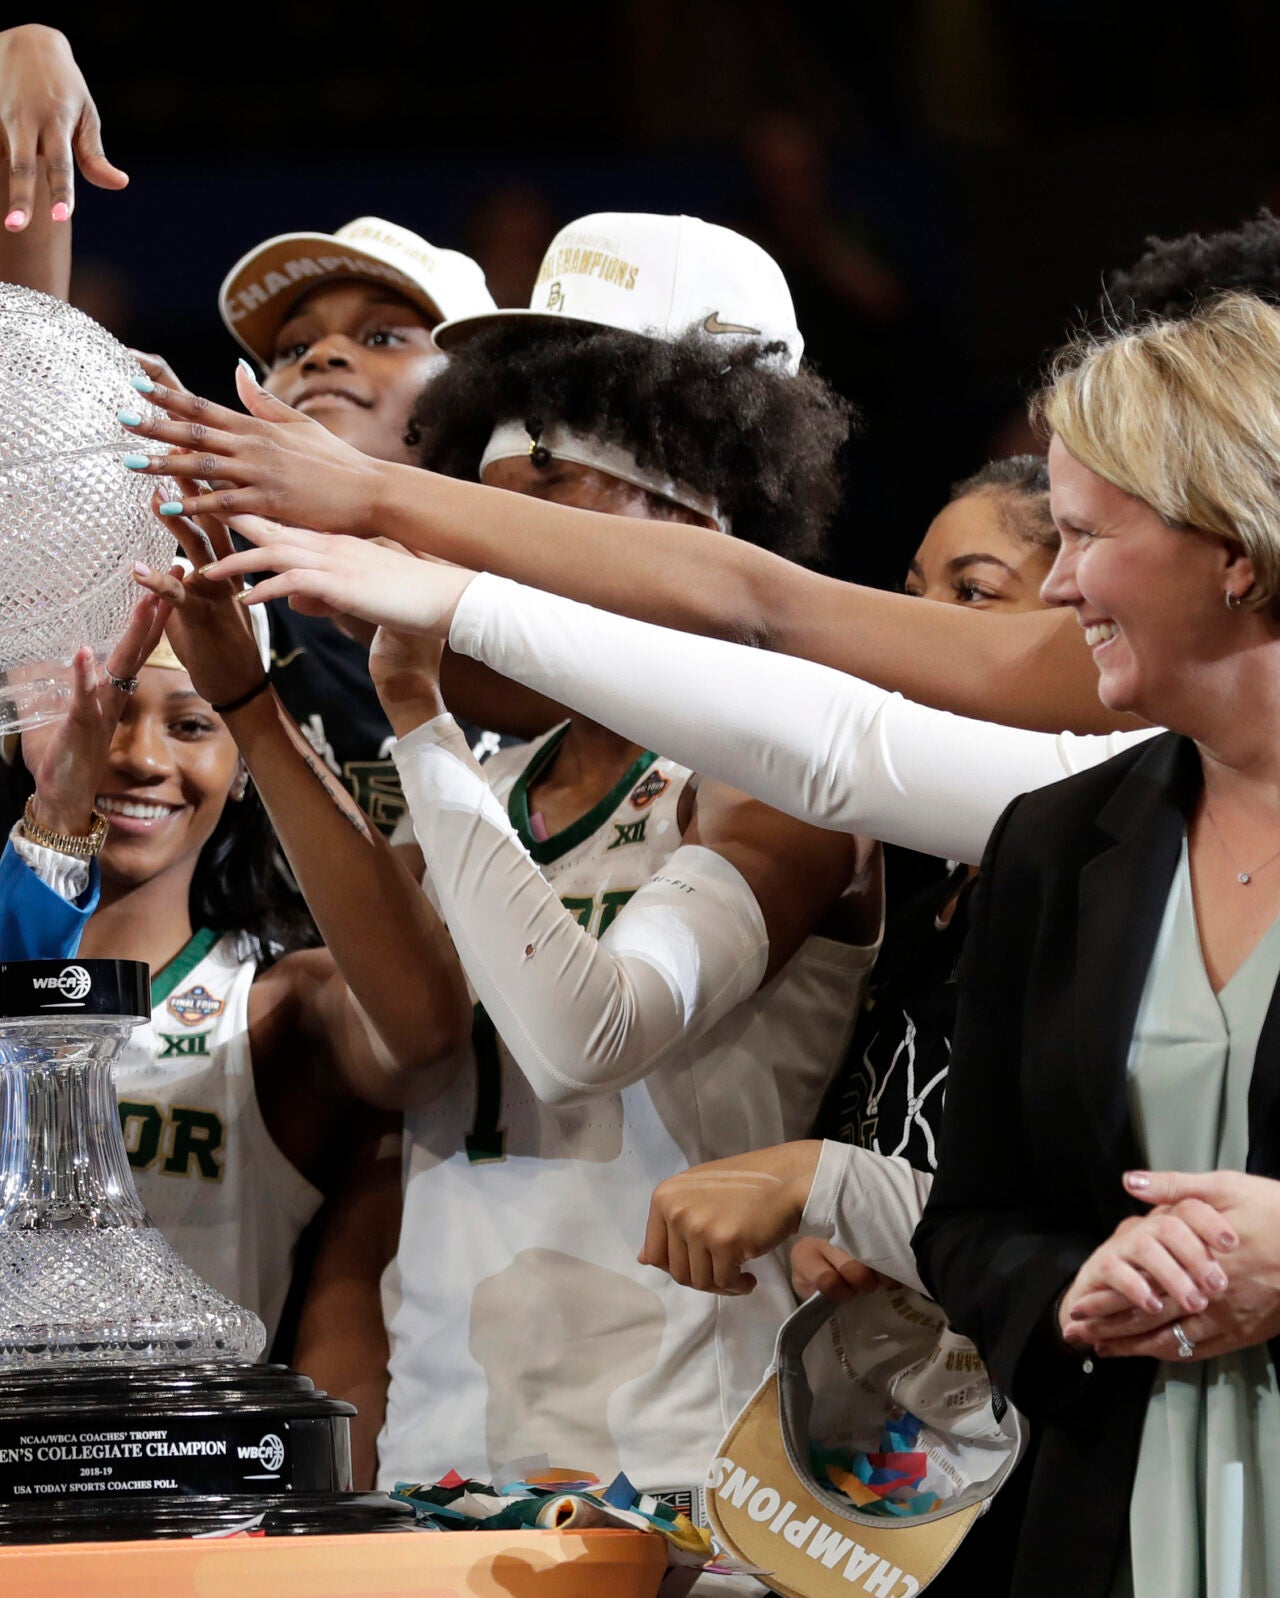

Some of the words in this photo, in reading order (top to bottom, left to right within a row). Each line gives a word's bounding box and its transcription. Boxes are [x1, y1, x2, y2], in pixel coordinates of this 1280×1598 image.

[556, 248, 639, 291] CHAMPIONS
[607, 813, 651, 850] XII
[32, 977, 77, 989] WBCA
[157, 1030, 212, 1059] XII
[20, 1434, 77, 1445] NCAA/WBCA
[129, 1430, 167, 1440] TROPHY
[37, 1443, 142, 1461] COLLEGIATE
[146, 1440, 227, 1457] CHAMPION
[237, 1446, 274, 1459] WBCA
[80, 1467, 113, 1477] 2018-19
[13, 1484, 32, 1495] USA
[34, 1483, 67, 1494] TODAY
[69, 1482, 106, 1492] SPORTS
[107, 1480, 152, 1491] COACHES
[154, 1479, 178, 1489] POLL
[704, 1457, 919, 1598] CHAMPIONS
